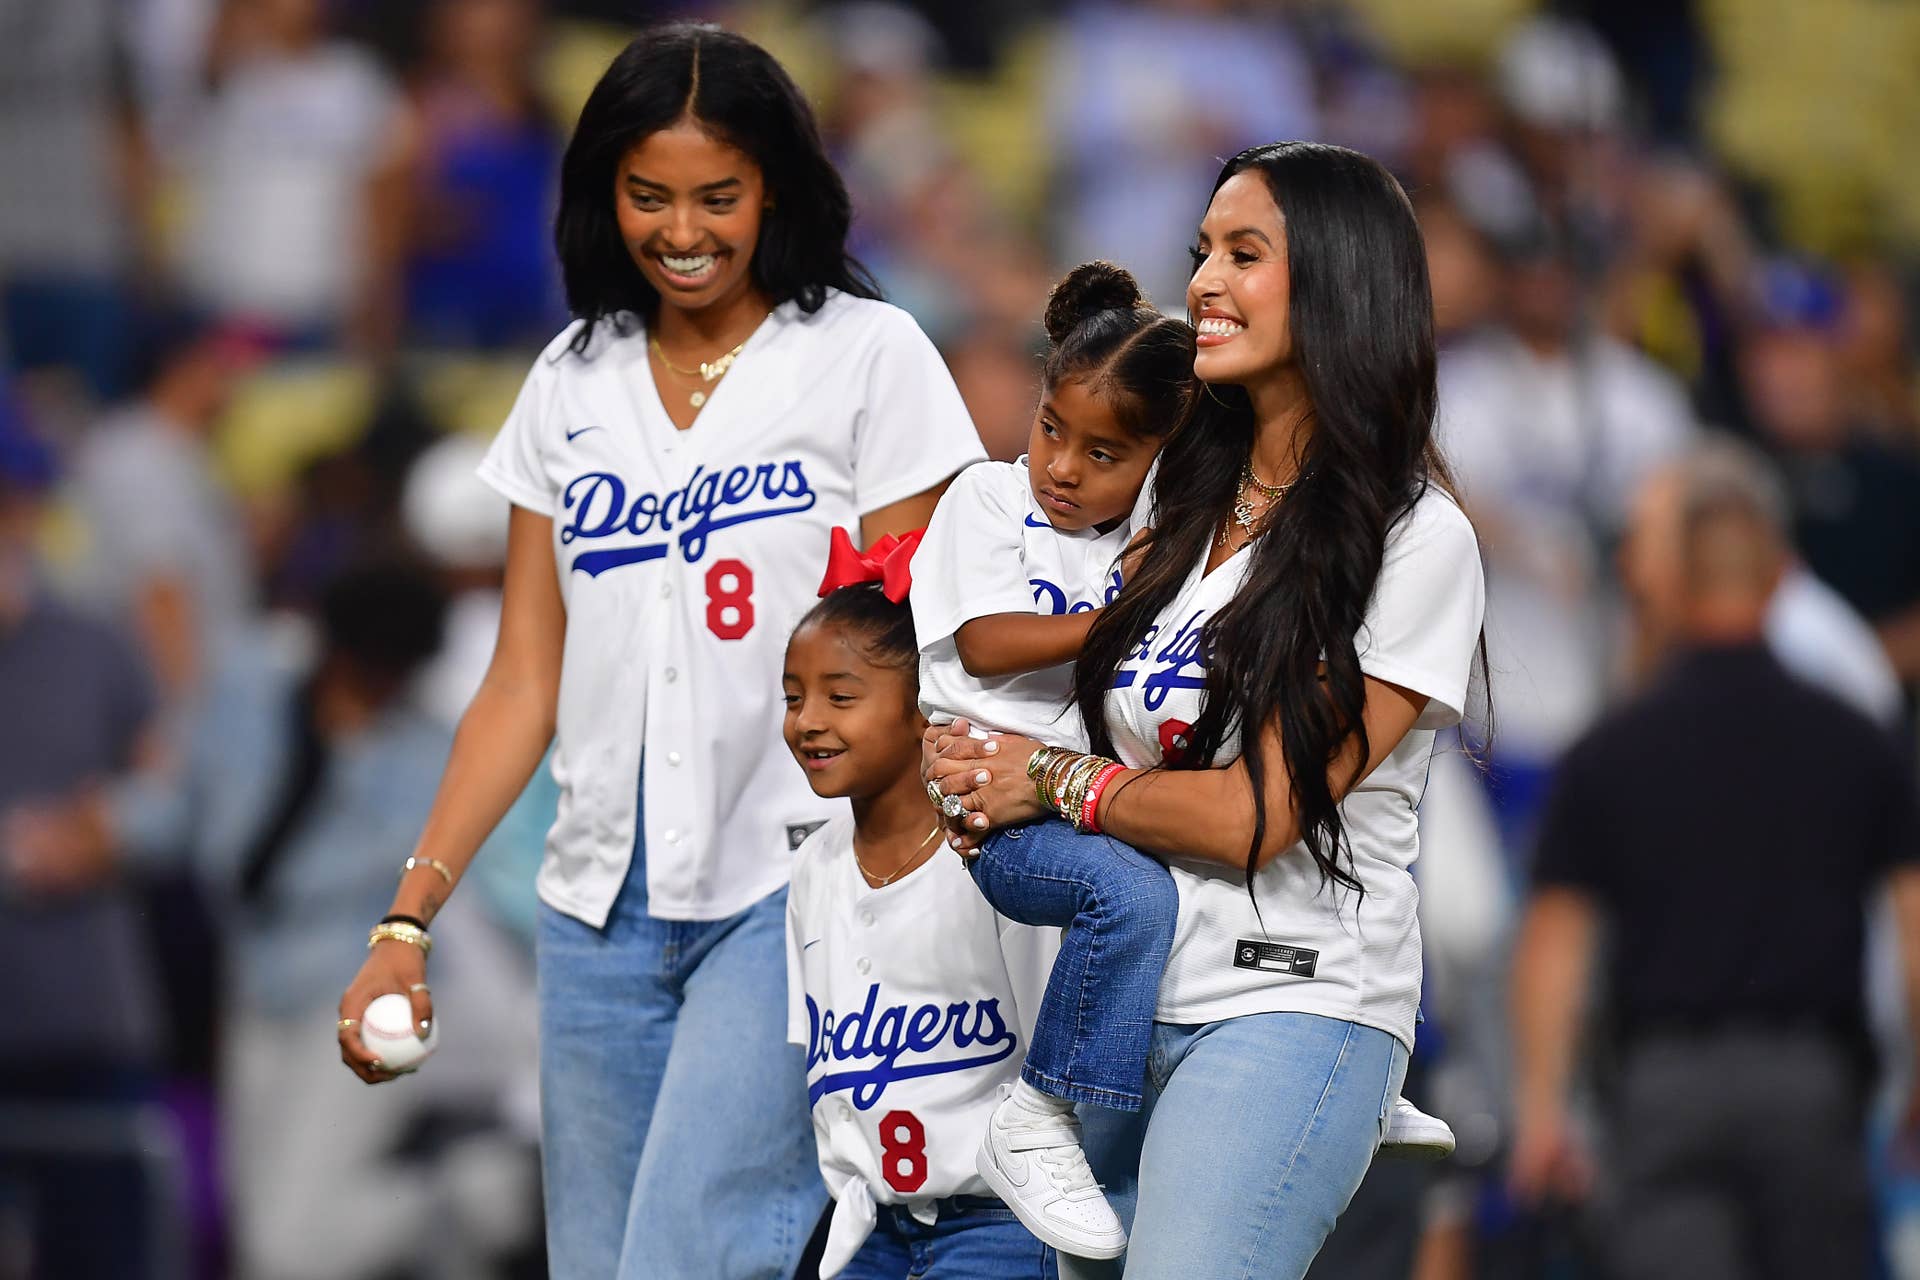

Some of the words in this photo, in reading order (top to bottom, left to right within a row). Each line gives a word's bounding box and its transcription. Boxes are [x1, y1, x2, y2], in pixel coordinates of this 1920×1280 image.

[561, 460, 816, 565] Dodgers
[704, 558, 755, 640] 8
[878, 1109, 928, 1193] 8
